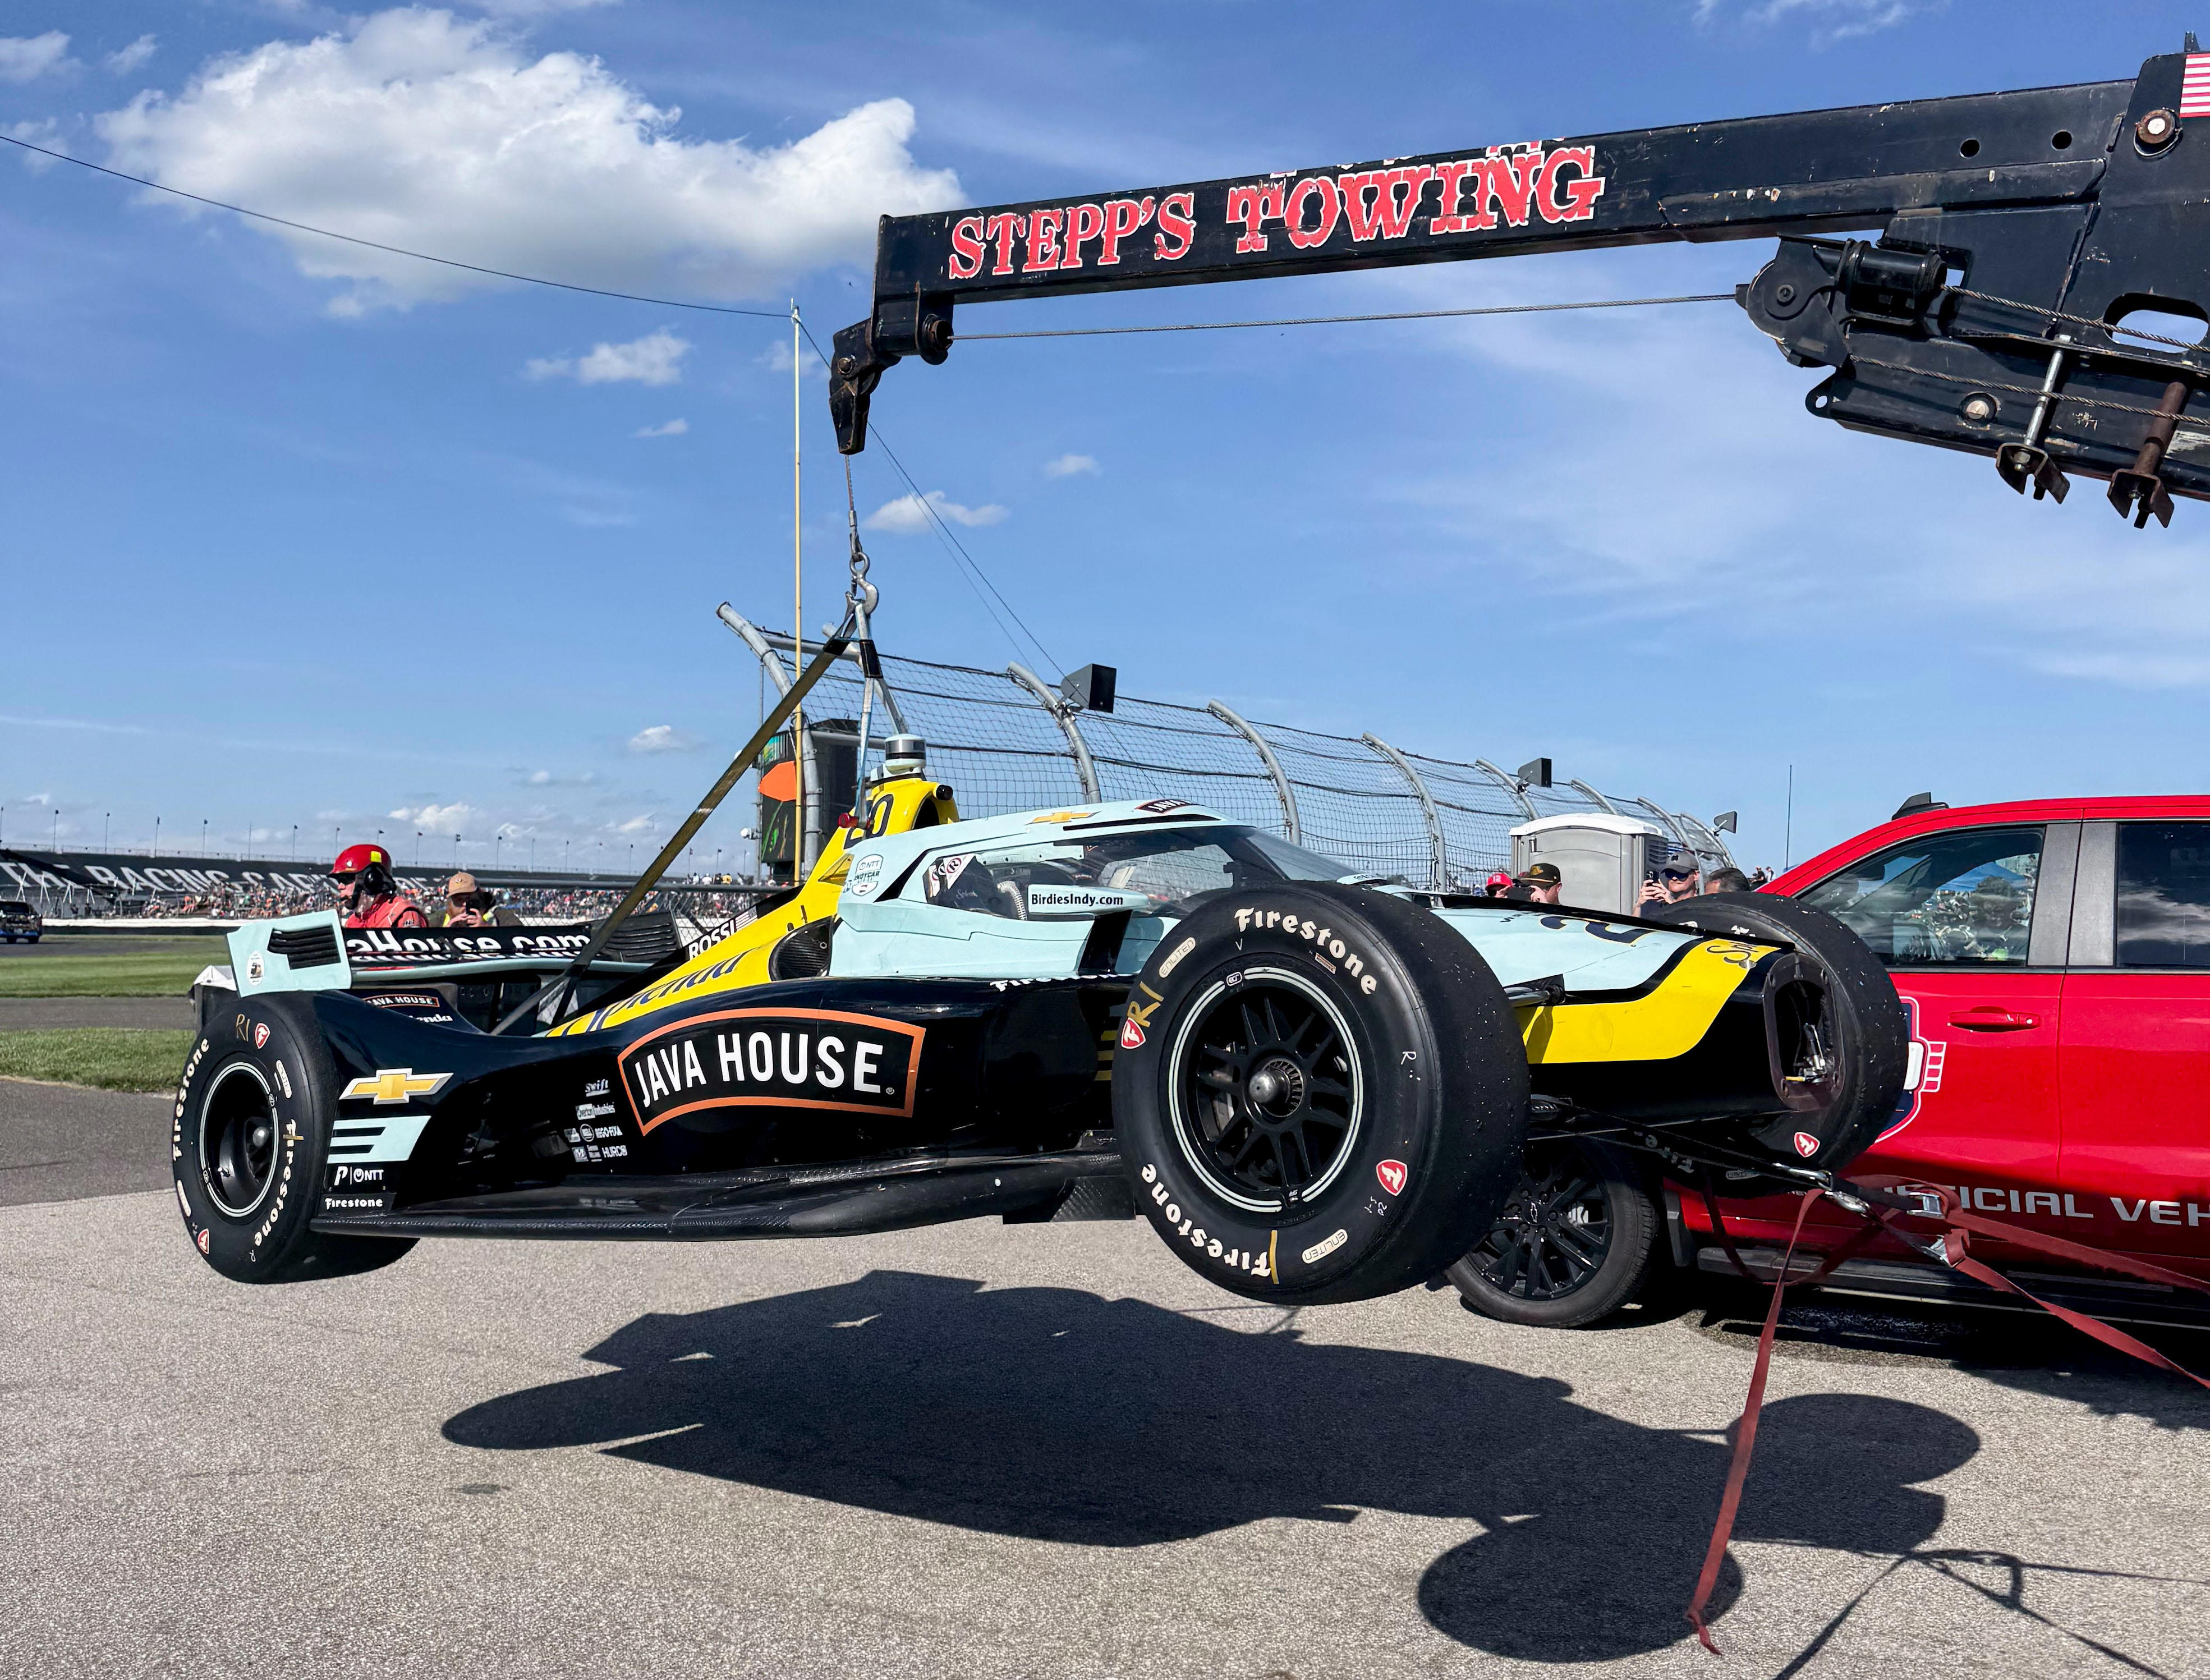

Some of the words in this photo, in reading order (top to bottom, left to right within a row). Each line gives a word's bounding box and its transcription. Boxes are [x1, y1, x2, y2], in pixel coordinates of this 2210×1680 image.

[949, 192, 1196, 279] STEPP'S
[1226, 145, 1605, 254] TOWING
[84, 866, 243, 893] RACING
[1032, 894, 1123, 907] BirdiesIndy.com
[688, 921, 737, 960] ROSSI
[1161, 939, 1194, 976] ENLITEN
[1234, 907, 1377, 995] Firestone
[635, 1040, 706, 1108] JAVA
[718, 1032, 883, 1093] HOUSE
[173, 1039, 209, 1161] Firestone
[254, 1119, 297, 1246] Firestone
[364, 1169, 384, 1181] NTT
[325, 1197, 383, 1210] Firestone
[1883, 1183, 2094, 1218] ICIAL
[1141, 1163, 1271, 1277] Firestone
[1304, 1231, 1346, 1261] ENLITEN
